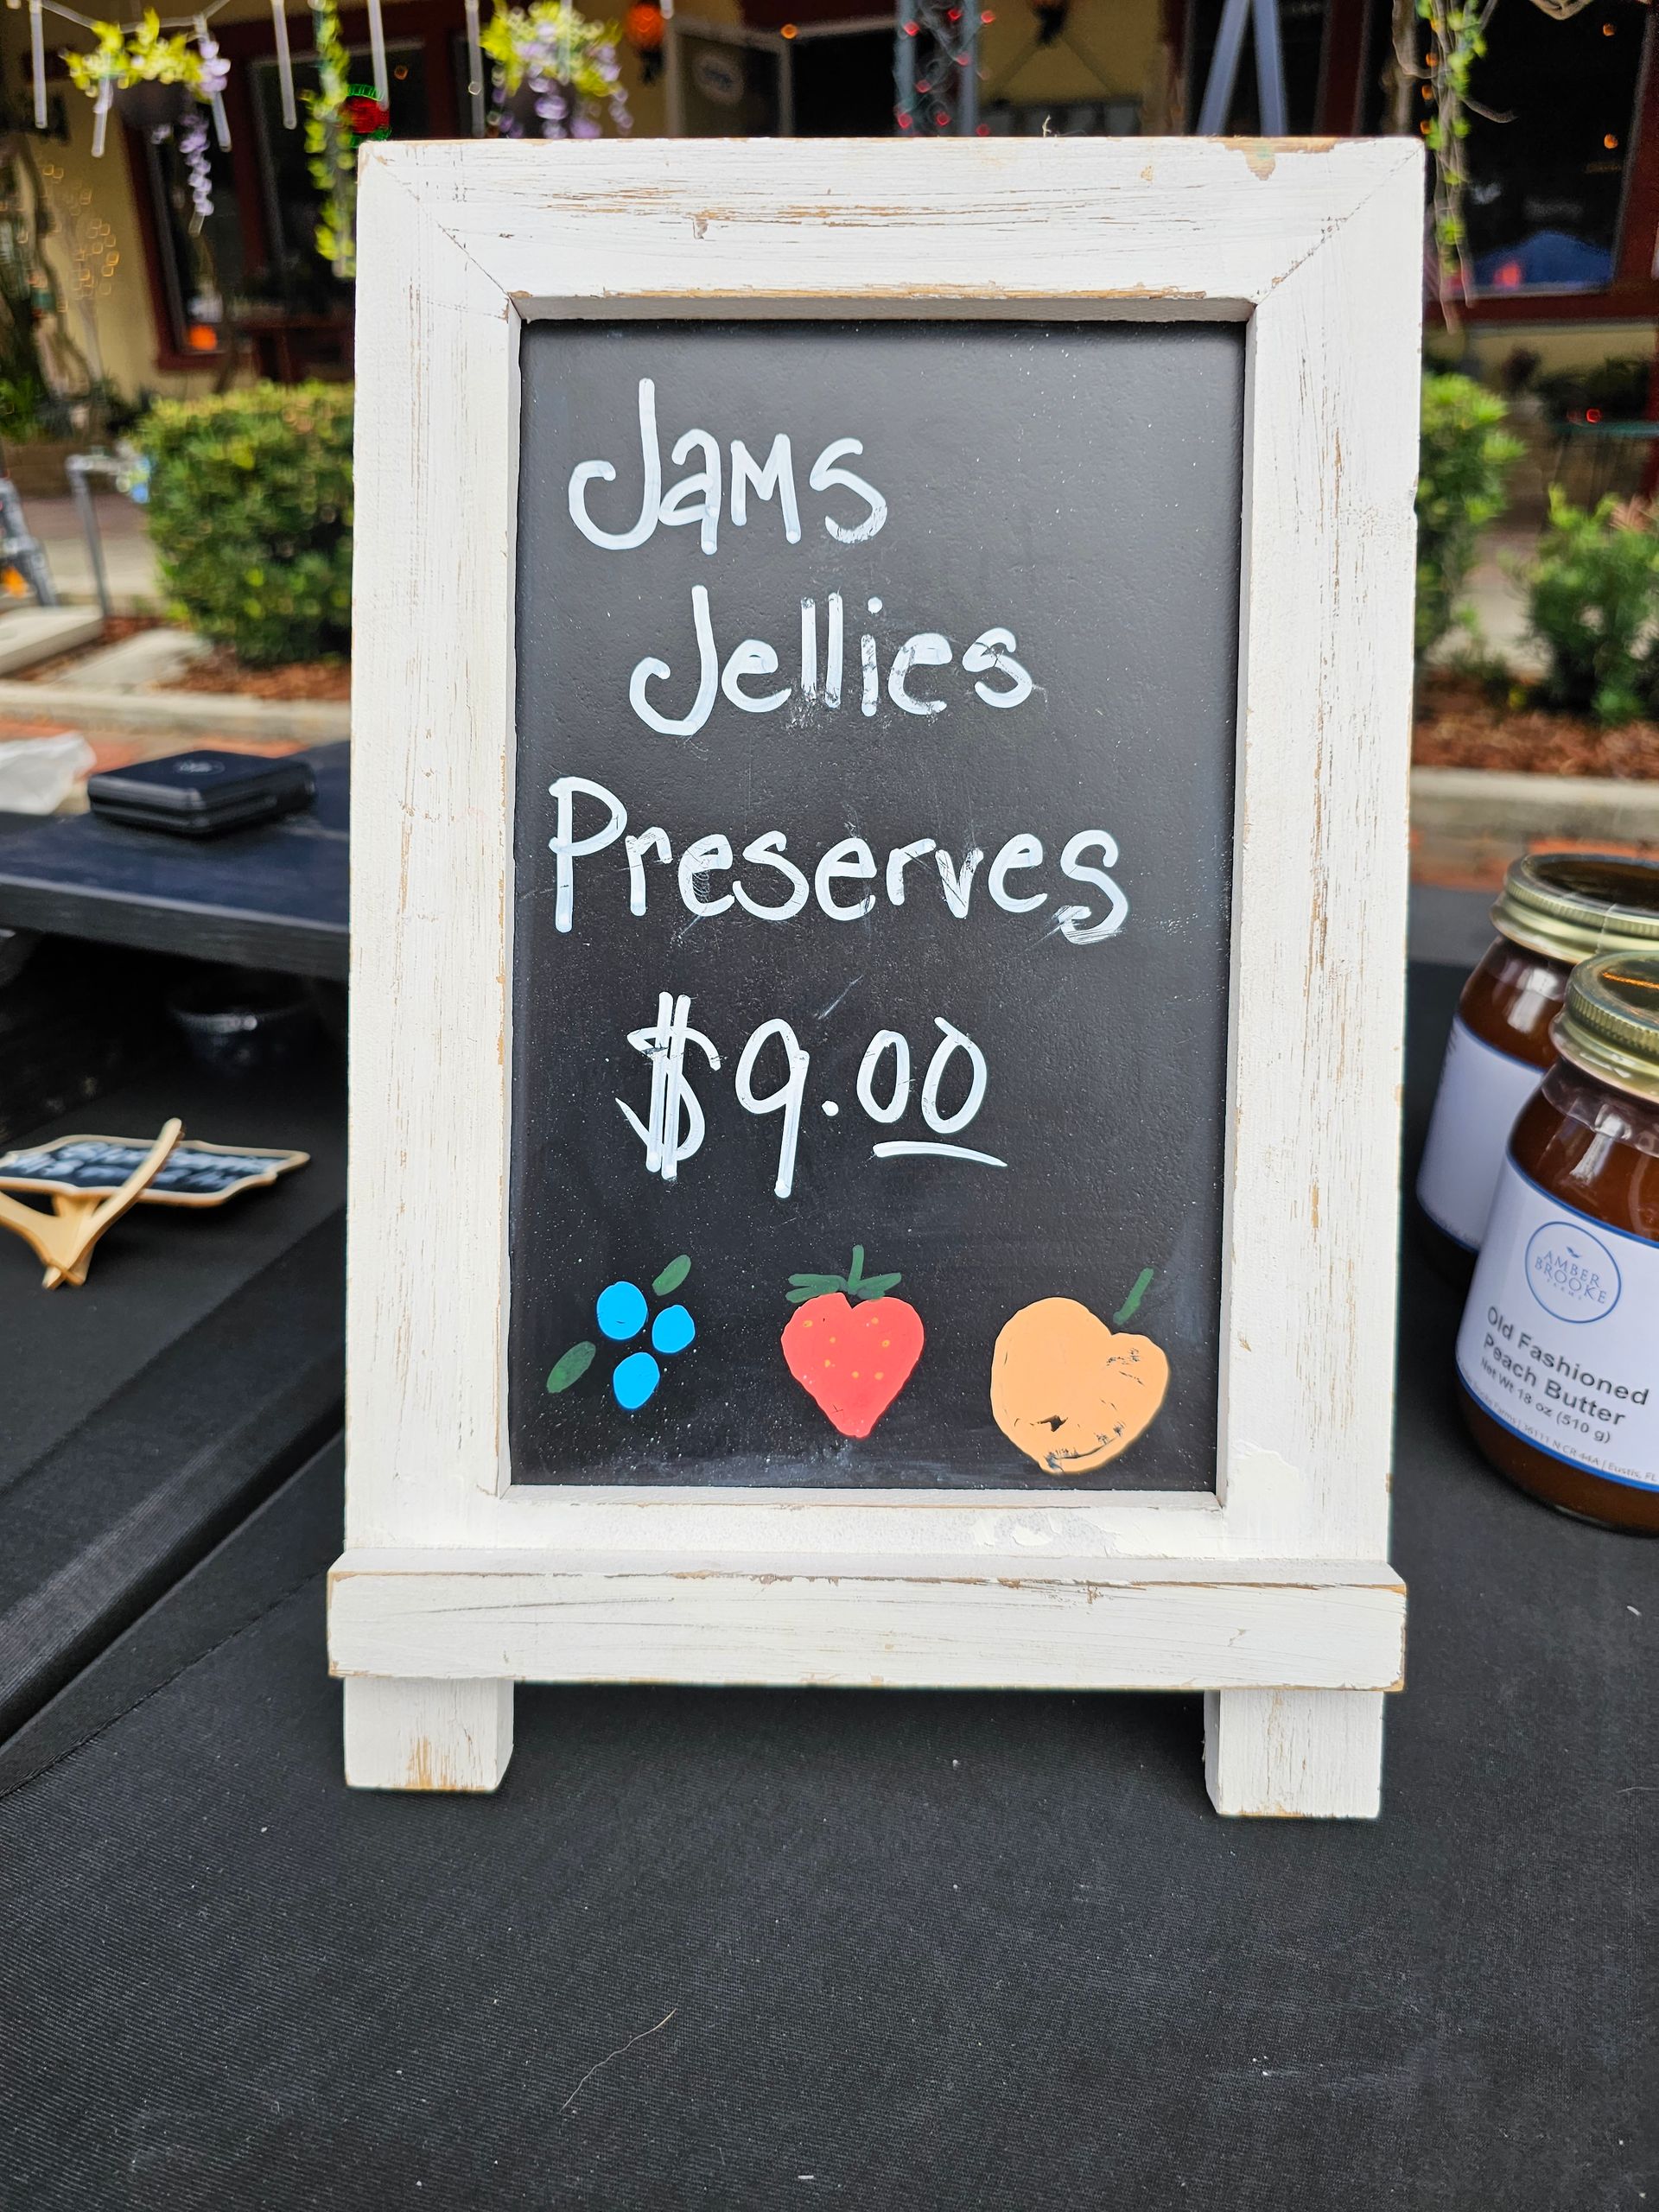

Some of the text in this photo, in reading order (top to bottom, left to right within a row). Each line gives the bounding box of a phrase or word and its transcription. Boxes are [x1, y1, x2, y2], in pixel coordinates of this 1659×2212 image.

[629, 585, 1034, 736] Jellies
[548, 777, 1129, 945] Preserves
[615, 991, 988, 1198] $9.00
[1535, 1256, 1607, 1304] BROOKE
[1543, 1250, 1600, 1288] AMBER
[1484, 1333, 1537, 1387] Peach
[1543, 1378, 1626, 1425] Butter
[1487, 1306, 1514, 1340] Old
[1517, 1332, 1649, 1406] Fashioned
[1498, 1372, 1514, 1394] Wt
[1517, 1389, 1533, 1405] 18
[1535, 1402, 1553, 1417] oz
[1556, 1411, 1590, 1433] (510
[1593, 1430, 1611, 1444] g)
